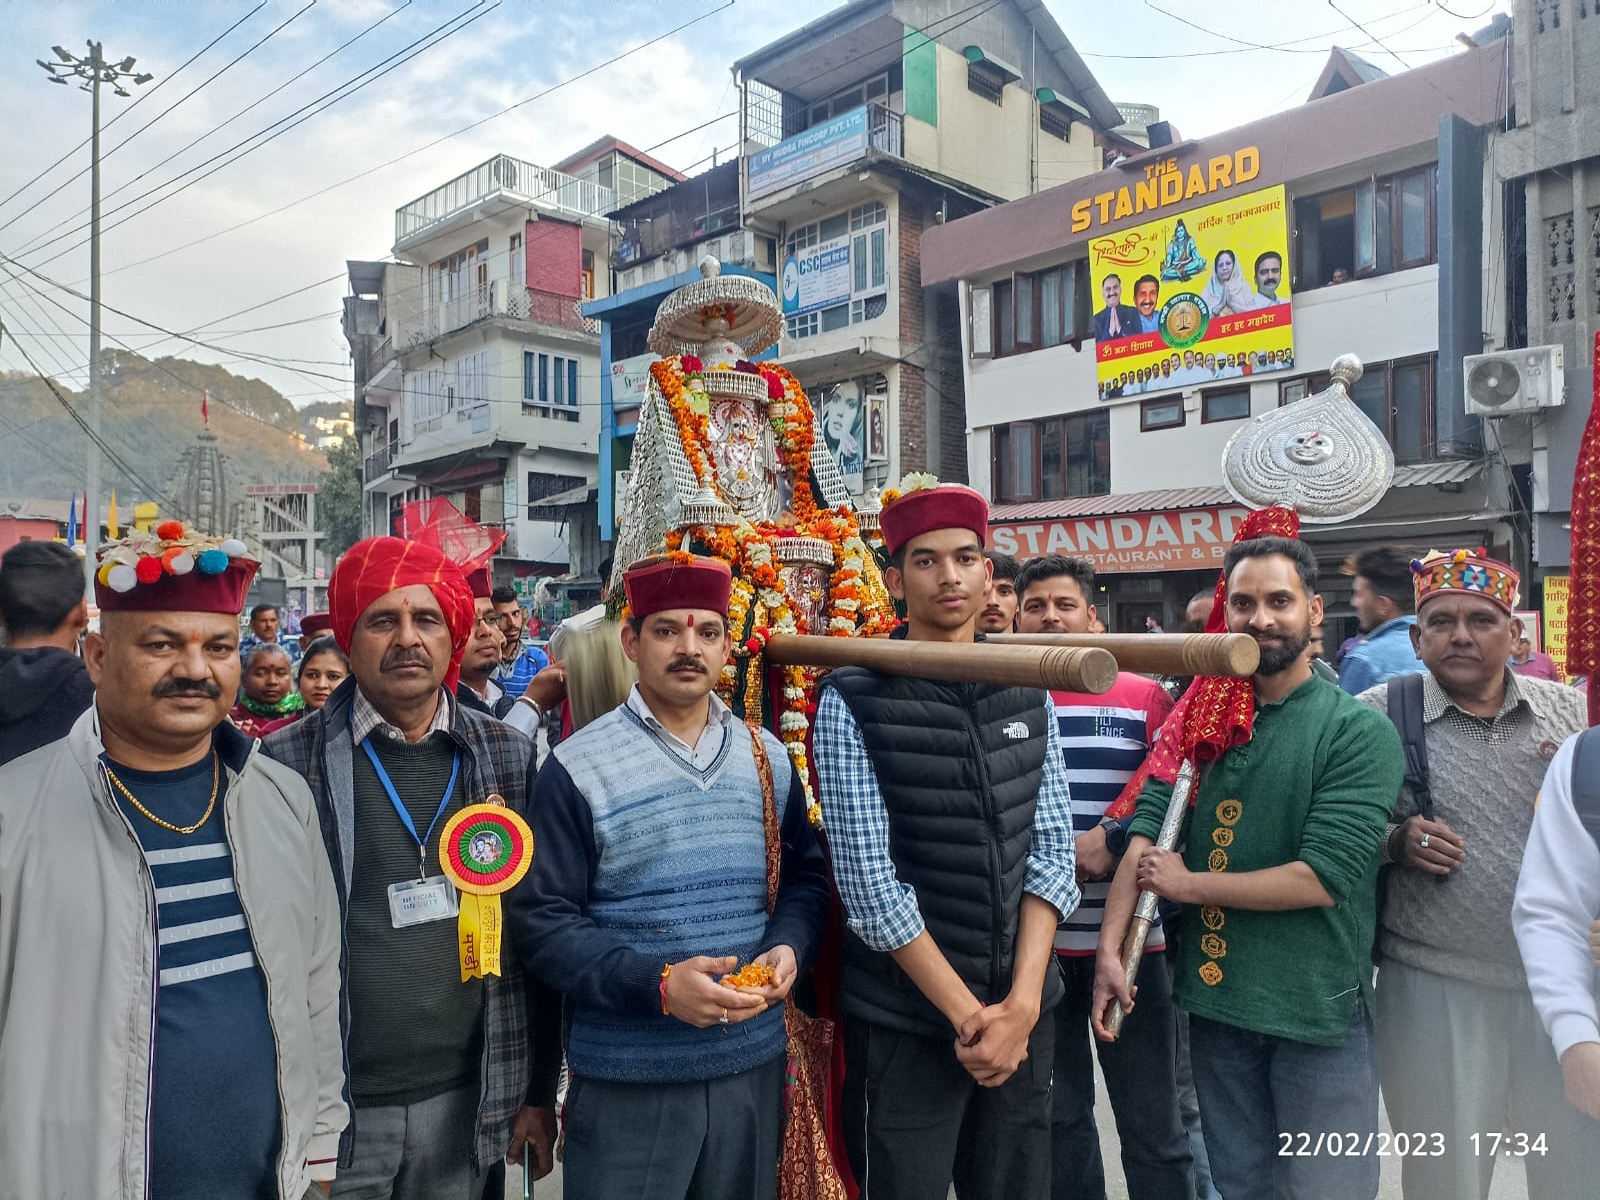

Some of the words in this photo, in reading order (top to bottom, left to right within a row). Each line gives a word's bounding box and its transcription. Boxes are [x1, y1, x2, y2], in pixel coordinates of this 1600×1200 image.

[1144, 157, 1179, 181] THE
[1071, 146, 1261, 234] STANDARD
[1198, 215, 1224, 231] हार्दिक
[800, 255, 820, 276] CSC
[1247, 314, 1276, 327] महादेव
[992, 509, 1249, 556] STANDARD
[1191, 547, 1205, 559] &
[1100, 707, 1117, 716] RES
[1100, 726, 1125, 738] ENCE
[417, 899, 438, 908] DUTY
[463, 932, 479, 971] मण्डी
